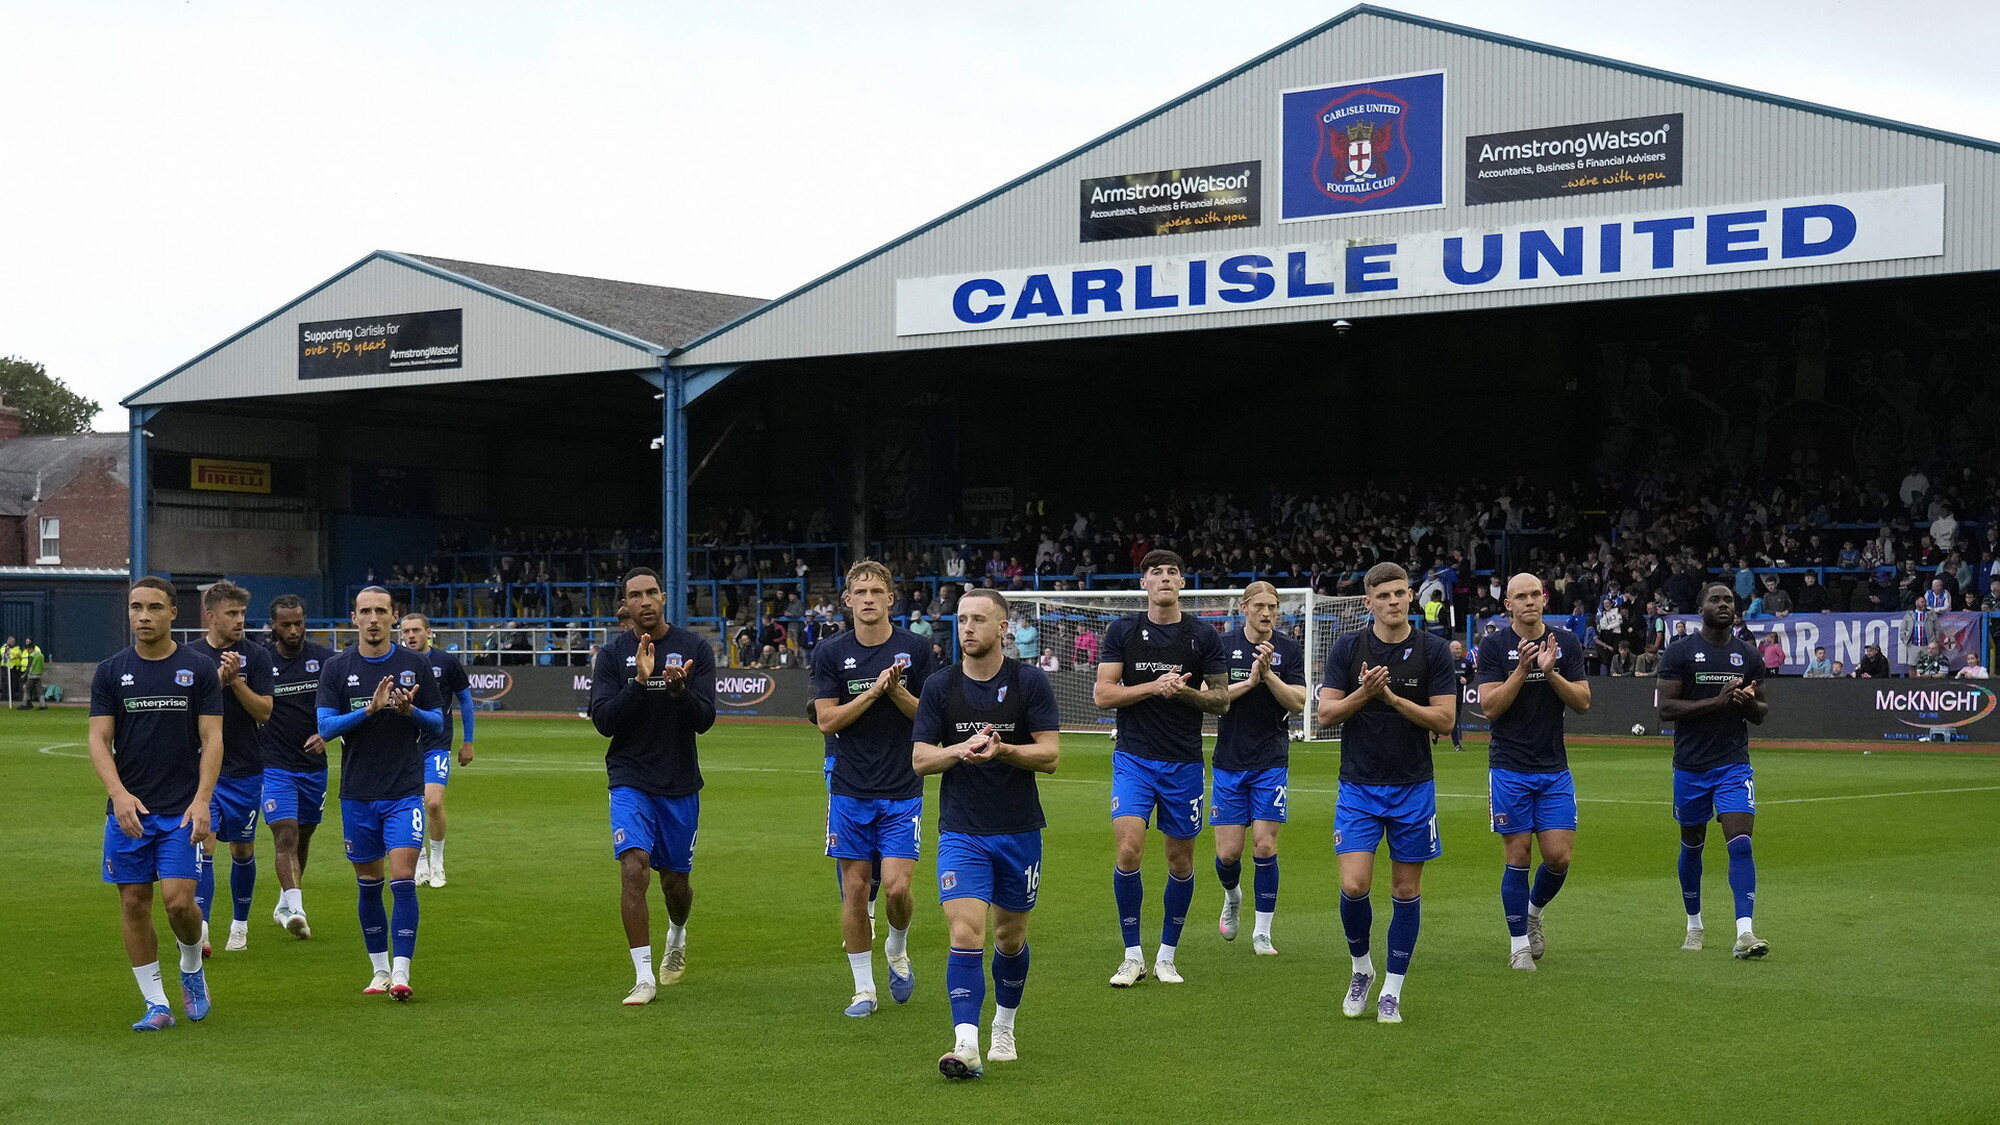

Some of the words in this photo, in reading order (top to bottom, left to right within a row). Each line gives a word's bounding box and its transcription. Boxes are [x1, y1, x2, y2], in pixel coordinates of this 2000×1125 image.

[1323, 104, 1365, 123] CARLISLE
[1366, 103, 1400, 115] UNITED
[1478, 165, 1534, 179] Accountants,
[1536, 161, 1575, 173] Business
[1577, 159, 1584, 169] &
[1585, 154, 1625, 167] Financial
[1626, 152, 1666, 164] Advisers
[1326, 182, 1371, 193] FOOTBALL
[1372, 176, 1396, 190] CLUB
[1602, 168, 1635, 184] with
[1637, 171, 1666, 185] you
[1090, 207, 1138, 219] Accountants,
[1138, 203, 1172, 214] Business
[1172, 202, 1179, 211] &
[1180, 199, 1213, 210] Financial
[1213, 196, 1248, 207] Advisers
[1194, 211, 1221, 225] with
[1223, 214, 1248, 226] you
[952, 243, 1399, 324] CARLISLE
[1443, 203, 1857, 286] UNITED
[304, 328, 353, 344] Supporting
[354, 325, 386, 338] Carlisle
[386, 323, 400, 335] for
[304, 346, 329, 357] over
[332, 342, 351, 359] 150
[355, 339, 387, 357] years
[198, 464, 264, 487] PIRELLI
[275, 682, 318, 693] enterprise
[468, 674, 505, 689] KNIGHT
[715, 677, 767, 694] cKNIGHT
[128, 698, 187, 709] enterprise
[1875, 690, 1981, 711] McKNIGHT
[433, 755, 449, 773] 14
[244, 809, 257, 830] 2
[411, 808, 423, 832] 8
[1024, 861, 1040, 893] 16
